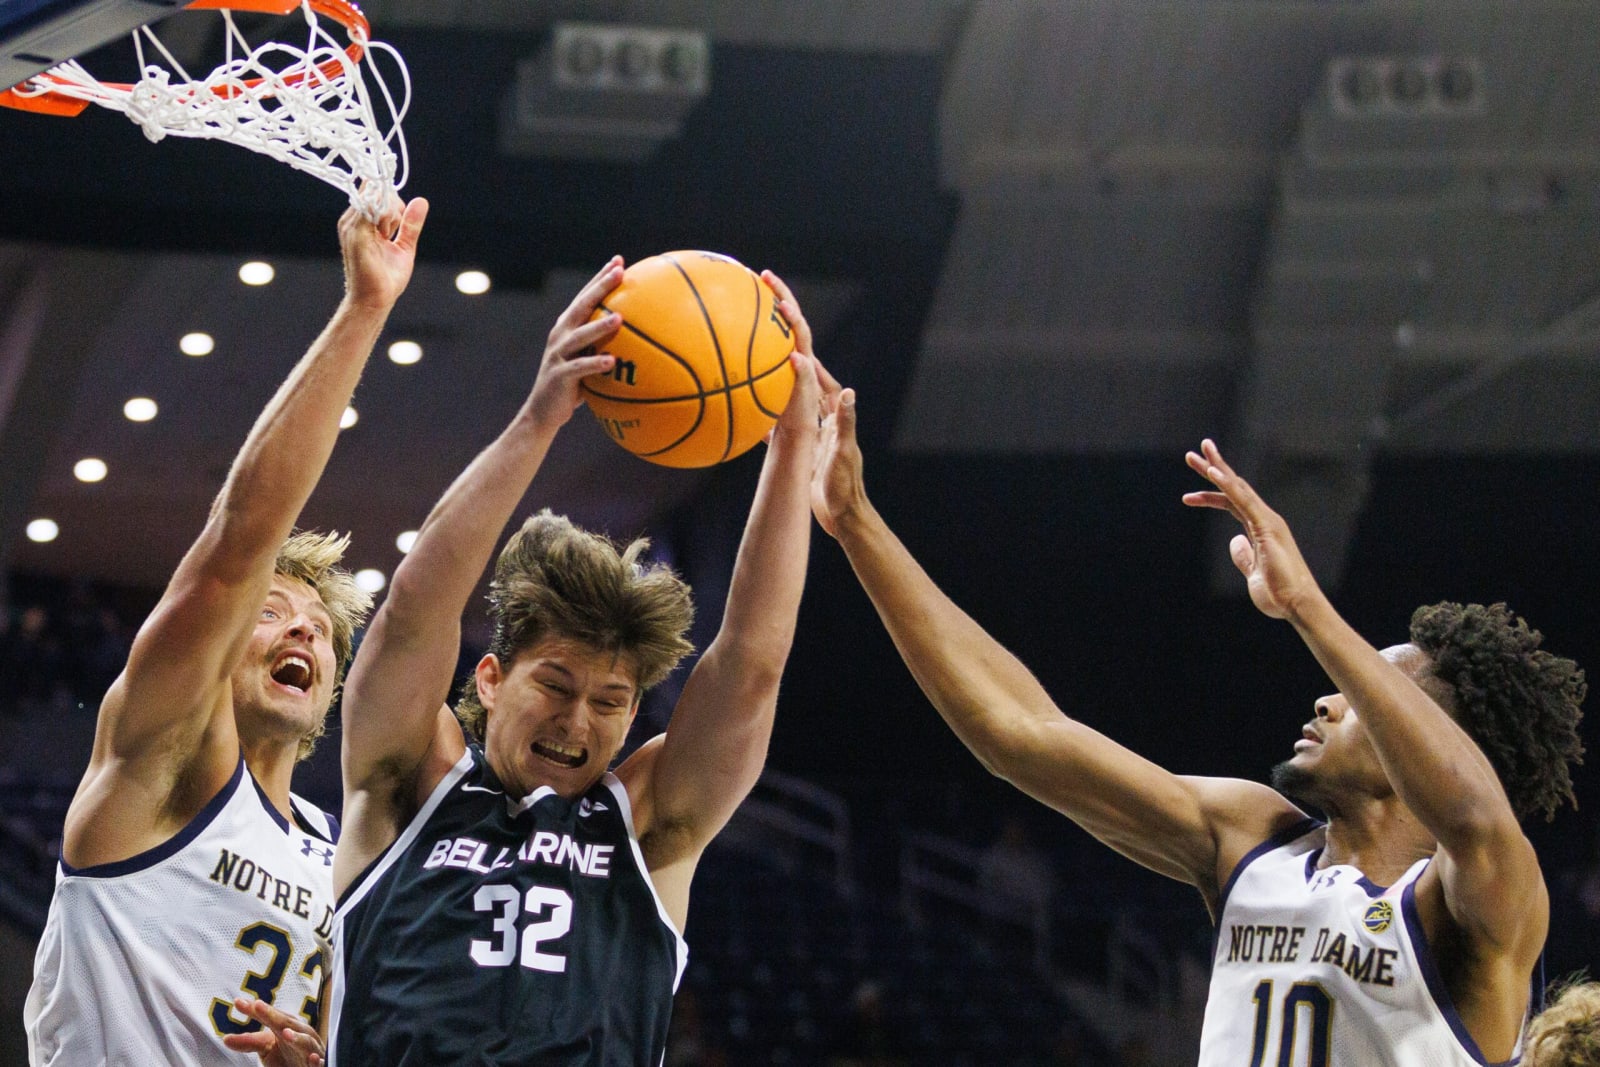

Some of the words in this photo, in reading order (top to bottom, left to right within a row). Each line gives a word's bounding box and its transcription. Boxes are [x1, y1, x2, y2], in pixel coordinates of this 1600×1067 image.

[210, 848, 313, 920] NOTRE
[469, 883, 573, 973] 32
[1227, 925, 1304, 963] NOTRE
[1311, 928, 1398, 987] DAME
[1250, 979, 1334, 1067] 10
